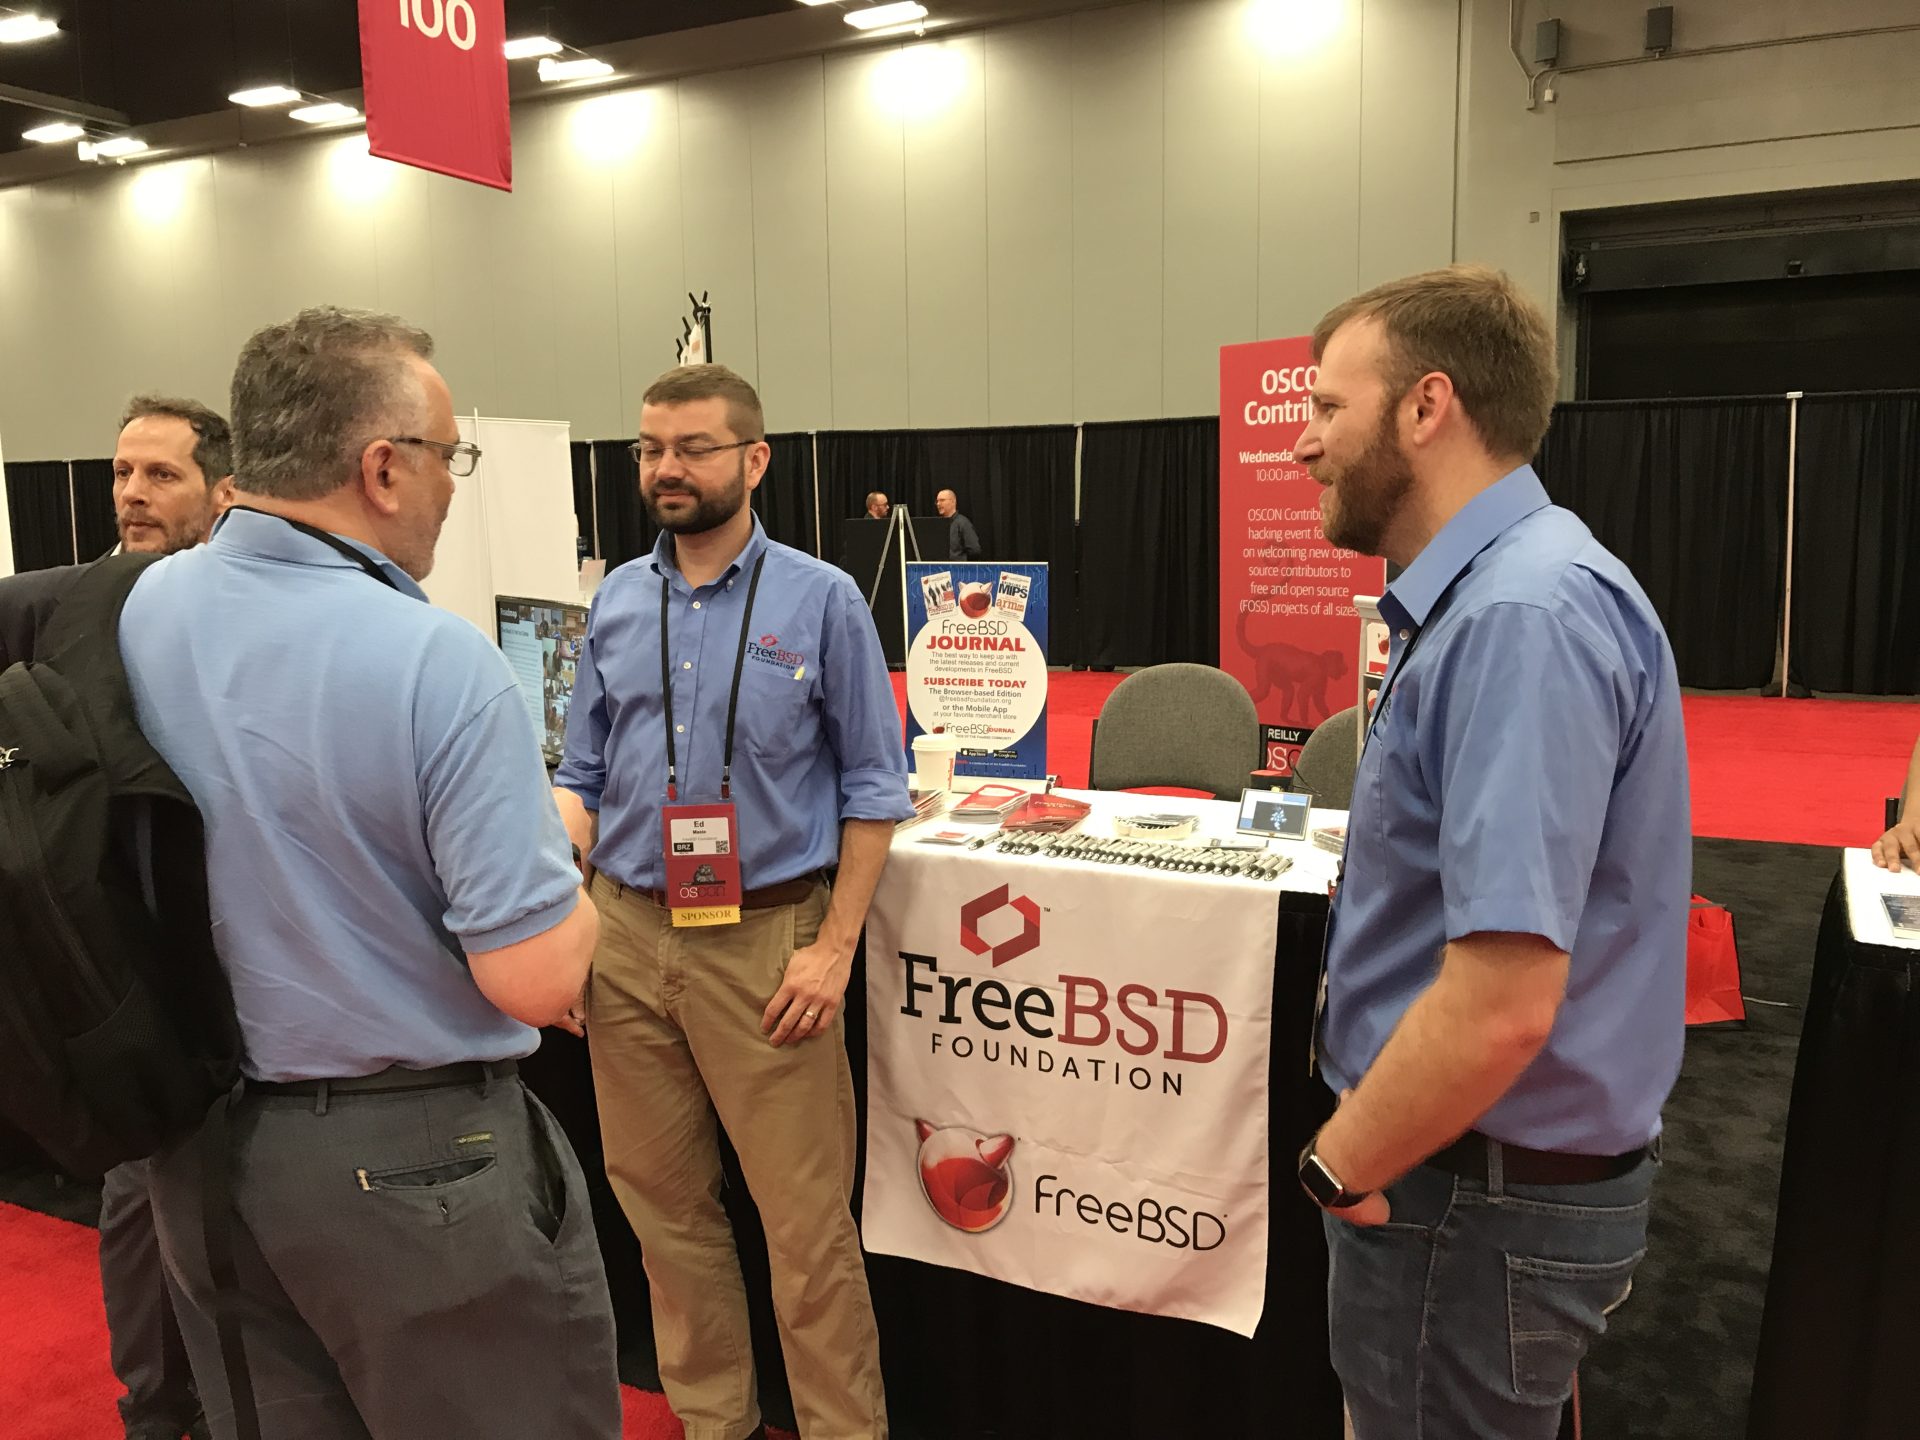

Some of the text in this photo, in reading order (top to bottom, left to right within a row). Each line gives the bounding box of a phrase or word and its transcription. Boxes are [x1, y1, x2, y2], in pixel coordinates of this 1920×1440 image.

[400, 0, 476, 50] 100
[1262, 365, 1320, 395] OSCO
[1248, 508, 1282, 521] OSCON
[1248, 527, 1283, 543] hacking
[1284, 528, 1311, 540] event
[1243, 545, 1358, 561] on welcoming new open
[1248, 564, 1352, 578] source contributors to
[998, 583, 1028, 599] MIPS
[1250, 580, 1350, 598] free and open source
[1239, 599, 1270, 614] (FOSS)
[1271, 602, 1309, 616] projects
[1310, 602, 1321, 615] of
[1322, 602, 1333, 616] all
[942, 620, 1008, 636] FreeBSD
[926, 635, 1026, 652] JOURNAL
[746, 641, 805, 666] FreeBSD
[751, 655, 796, 671] FOUNDATION
[934, 665, 976, 673] developments
[923, 677, 1027, 689] SUBSCRIBE TODAY
[929, 687, 1022, 698] The Browser-based Edition
[965, 704, 991, 712] Mobile
[992, 706, 1008, 714] App
[946, 722, 989, 735] FreeBSD
[694, 820, 705, 828] Ed
[681, 909, 732, 921] SPONSOR
[898, 950, 1228, 1064] FreeBSD
[931, 1033, 1183, 1096] FOUNDATION
[1035, 1174, 1226, 1251] FreeBSD
